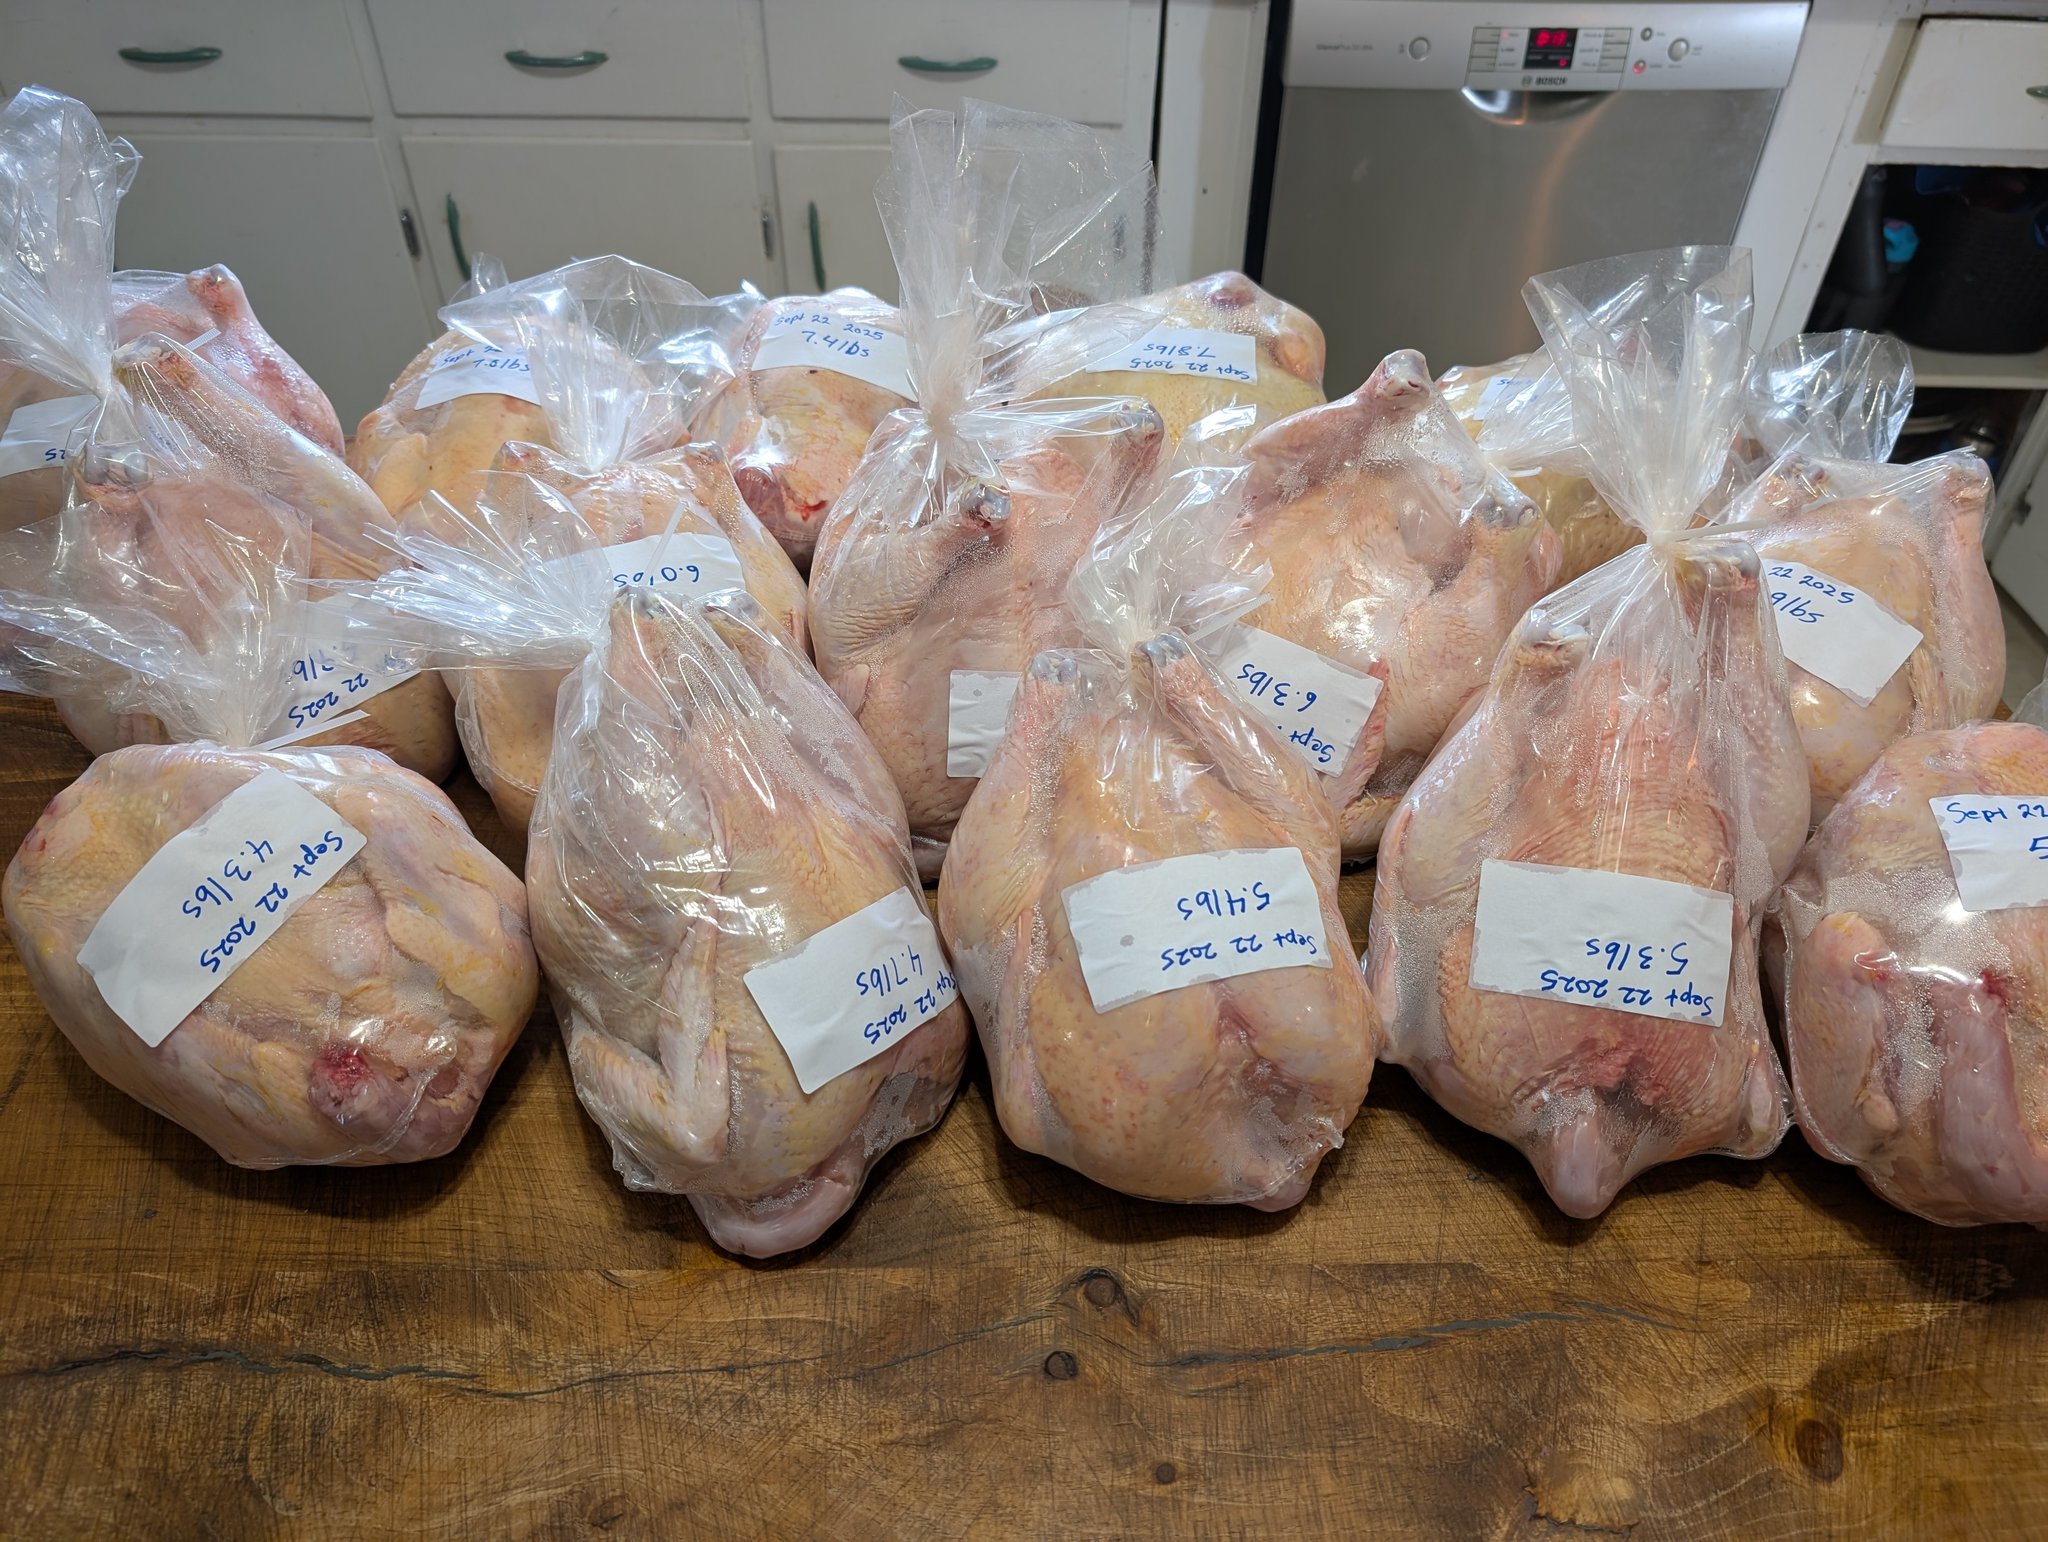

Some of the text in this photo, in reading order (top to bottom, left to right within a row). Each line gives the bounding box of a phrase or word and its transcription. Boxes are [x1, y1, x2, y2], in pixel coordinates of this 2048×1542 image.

[775, 313, 884, 341] Sept 22 2025
[1129, 358, 1250, 380] Sept 22 2025
[44, 448, 65, 462] 25
[1768, 566, 1856, 604] 22 2025
[1771, 591, 1825, 624] 9lbs
[288, 672, 369, 729] 22 2025
[1288, 727, 1336, 763] Sept
[1946, 802, 2009, 824] Sept
[200, 831, 343, 973] Sept 22 2025
[1160, 928, 1318, 971] Sept 22 2025
[914, 988, 936, 1014] 22
[1540, 969, 1714, 1016] Sept 22 2025
[864, 1004, 907, 1045] 2025
